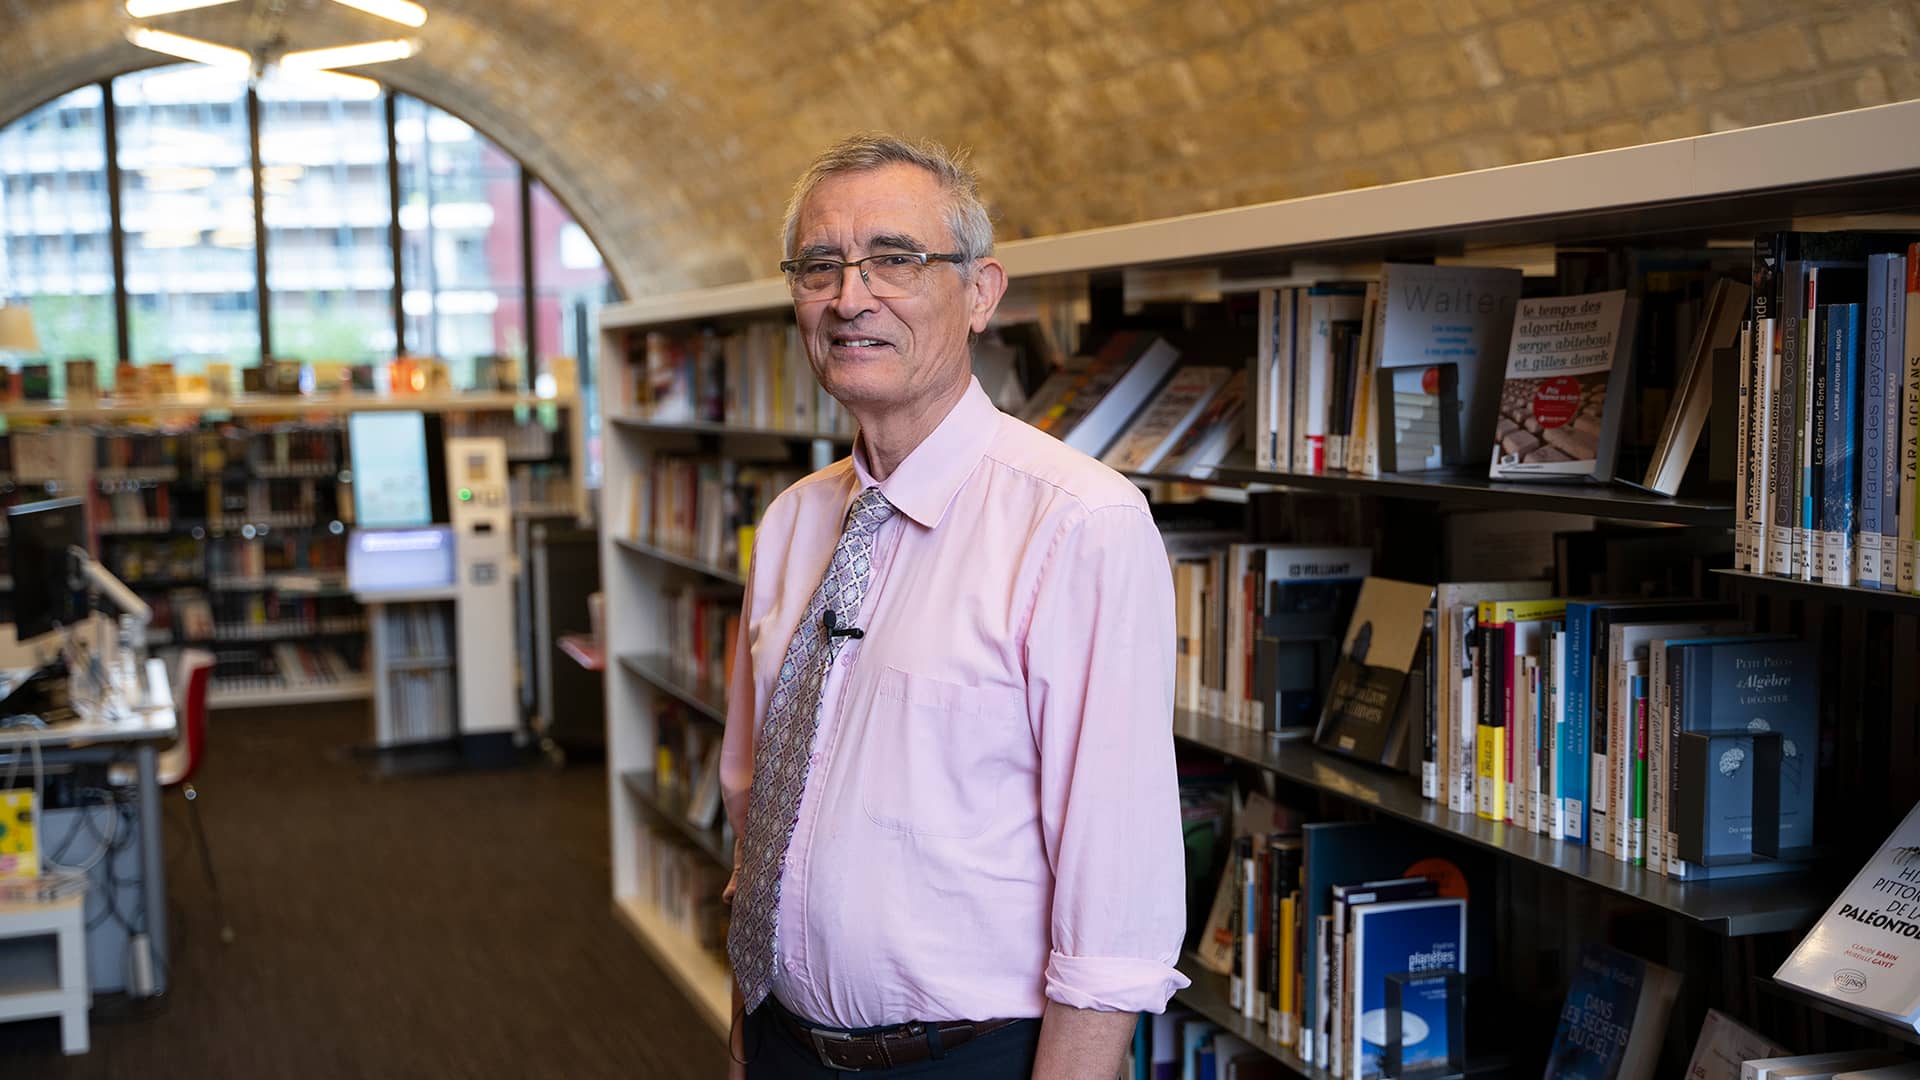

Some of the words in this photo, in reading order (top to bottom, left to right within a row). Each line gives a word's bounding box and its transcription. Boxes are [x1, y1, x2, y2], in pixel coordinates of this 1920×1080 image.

[1404, 285, 1508, 313] Walter
[1522, 305, 1534, 316] le
[1539, 304, 1576, 318] temps
[1580, 301, 1601, 313] des
[1520, 319, 1598, 337] algorithmes
[1517, 341, 1552, 353] serge
[1555, 332, 1611, 349] abiteboul
[1782, 316, 1797, 388] volcans
[1868, 305, 1884, 398] paysages
[1514, 359, 1529, 369] et
[1532, 356, 1568, 371] gilles
[1571, 350, 1609, 366] dowek
[1835, 352, 1842, 361] DE
[1816, 376, 1826, 407] Fonds
[1887, 372, 1897, 400] L'EAU
[1908, 356, 1920, 426] OCEANS
[1779, 394, 1792, 418] de
[1887, 402, 1895, 415] DE
[1815, 409, 1825, 445] Grands
[1865, 404, 1879, 440] des
[1771, 430, 1778, 443] DU
[1885, 417, 1896, 478] VOYAGEURS
[1815, 447, 1824, 465] Les
[1905, 437, 1917, 482] TARA
[1769, 447, 1777, 495] VOLCANS
[1776, 425, 1792, 523] Chasseurs
[1863, 446, 1878, 510] France
[1885, 480, 1893, 497] LES
[1736, 673, 1791, 692] d'Algèbre
[1886, 900, 1910, 917] DE
[1408, 951, 1455, 965] planètes
[1844, 950, 1871, 962] MIREILLE
[1871, 958, 1895, 969] GAYET
[1851, 943, 1876, 954] CLAUDE
[1836, 974, 1864, 988] ellipses
[1583, 992, 1616, 1020] DANS
[1560, 1004, 1582, 1025] LES
[1583, 1011, 1629, 1046] SECRETS
[1568, 1024, 1586, 1046] DU
[1585, 1034, 1608, 1058] CIEL
